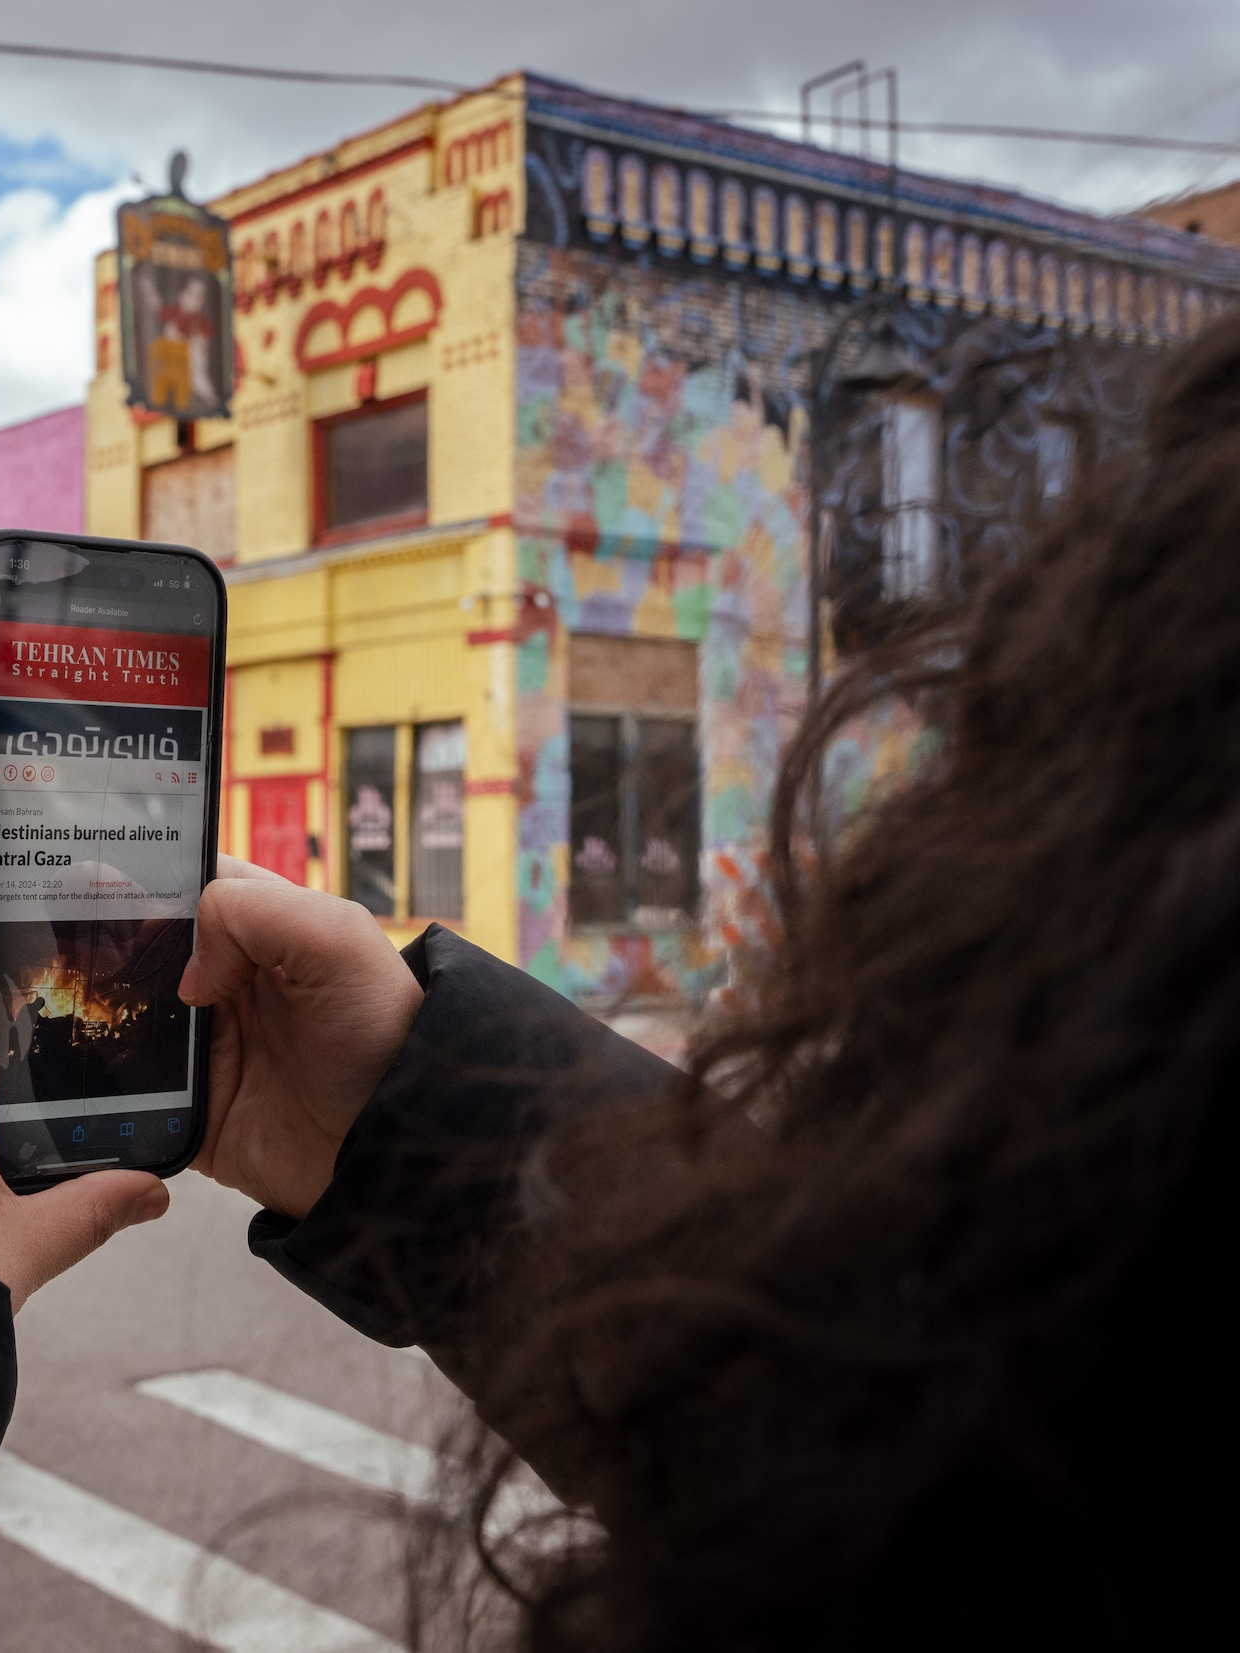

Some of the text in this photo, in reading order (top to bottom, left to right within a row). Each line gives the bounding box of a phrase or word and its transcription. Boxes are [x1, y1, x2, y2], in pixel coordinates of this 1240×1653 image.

[9, 559, 30, 570] 1:36
[169, 580, 180, 589] 5G
[70, 604, 129, 617] Reader Available
[12, 640, 181, 672] TEHRAN TIMES
[12, 663, 179, 686] Straight Truth
[16, 808, 44, 816] Bahrani
[74, 825, 125, 841] burned
[129, 825, 164, 841] alive
[166, 825, 179, 841] in
[34, 850, 72, 866] Gaza
[6, 880, 17, 890] 14,
[18, 880, 37, 889] 2024
[42, 880, 63, 889] 22:20
[89, 880, 133, 888] International
[22, 893, 37, 901] tent
[38, 894, 58, 903] camp
[59, 892, 69, 901] for
[70, 892, 83, 901] the
[83, 892, 116, 901] displaced
[116, 892, 123, 900] in
[123, 892, 145, 900] attack
[155, 891, 182, 900] hospital
